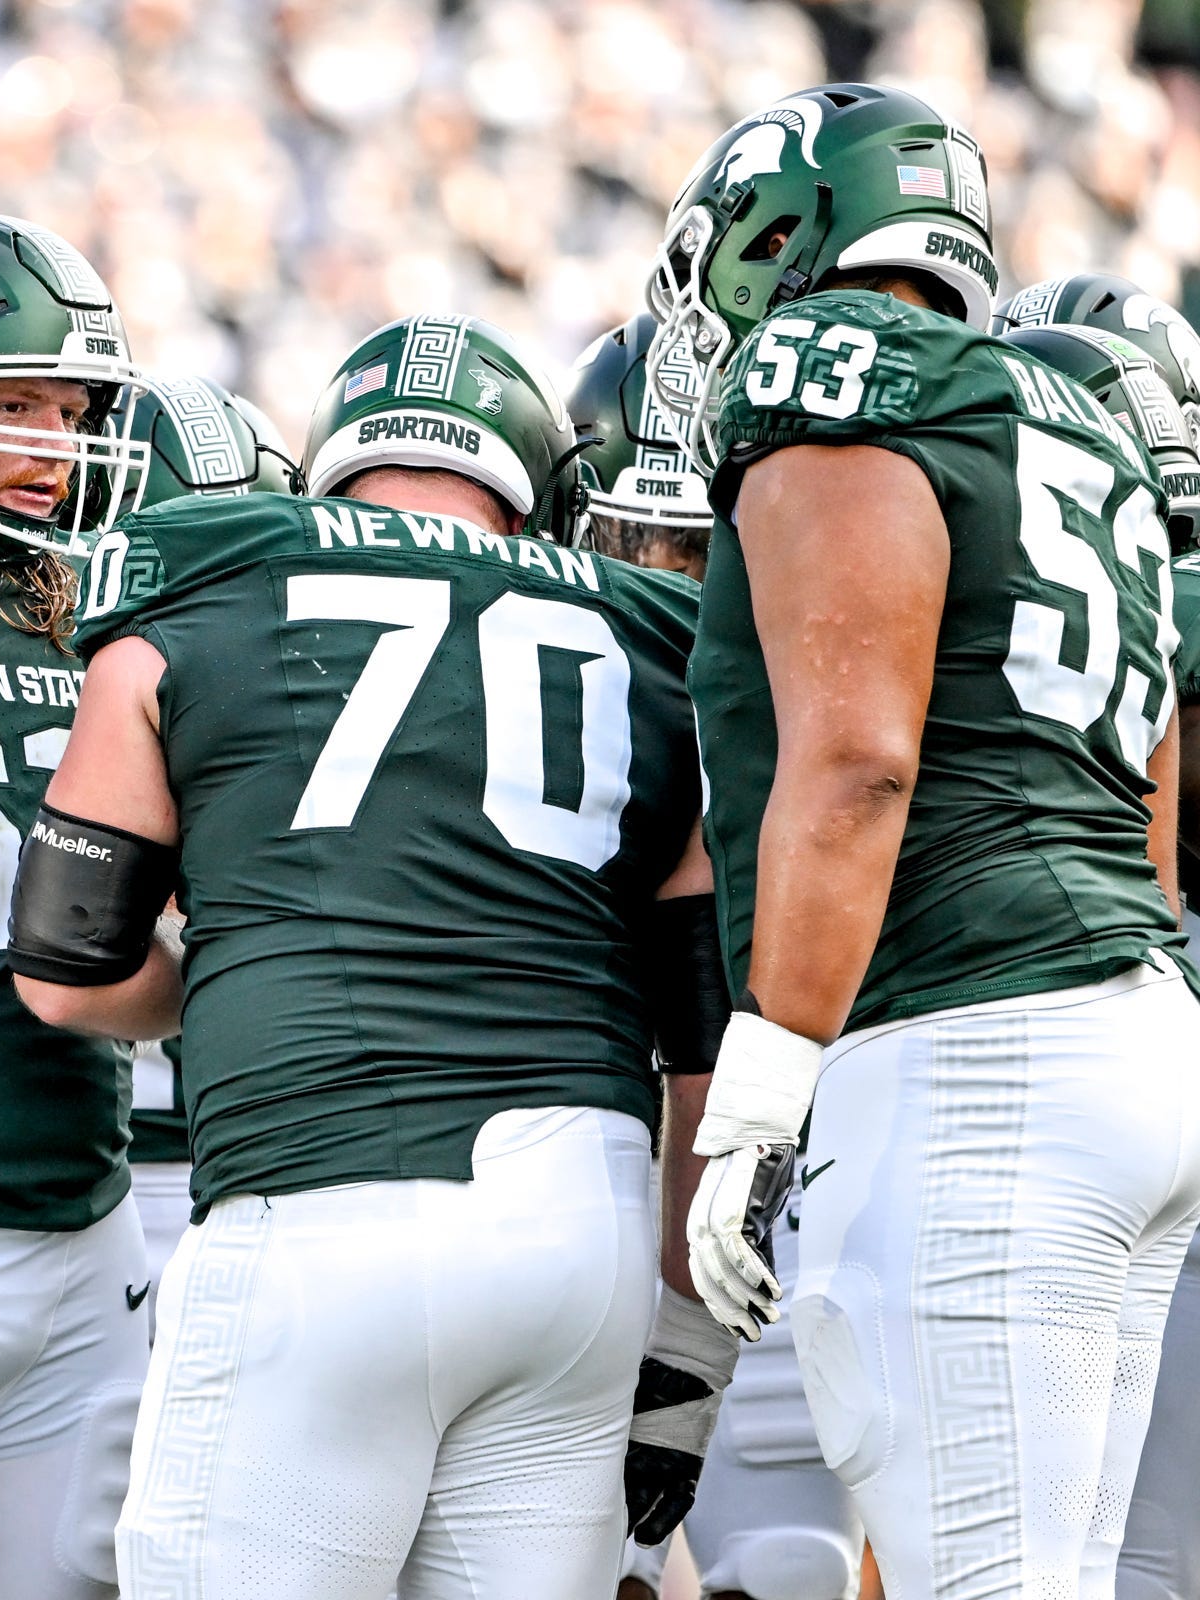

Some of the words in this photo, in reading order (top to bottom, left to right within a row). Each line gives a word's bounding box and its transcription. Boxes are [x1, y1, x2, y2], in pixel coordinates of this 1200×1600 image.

[925, 231, 999, 297] SPARTAN
[85, 337, 119, 357] STATE
[746, 319, 878, 420] 53
[358, 415, 481, 455] SPARTANS
[636, 478, 683, 498] STATE
[73, 530, 131, 622] 0
[310, 505, 600, 592] NEWMAN
[1002, 422, 1181, 778] 53
[17, 665, 86, 707] STA
[287, 574, 632, 873] 70
